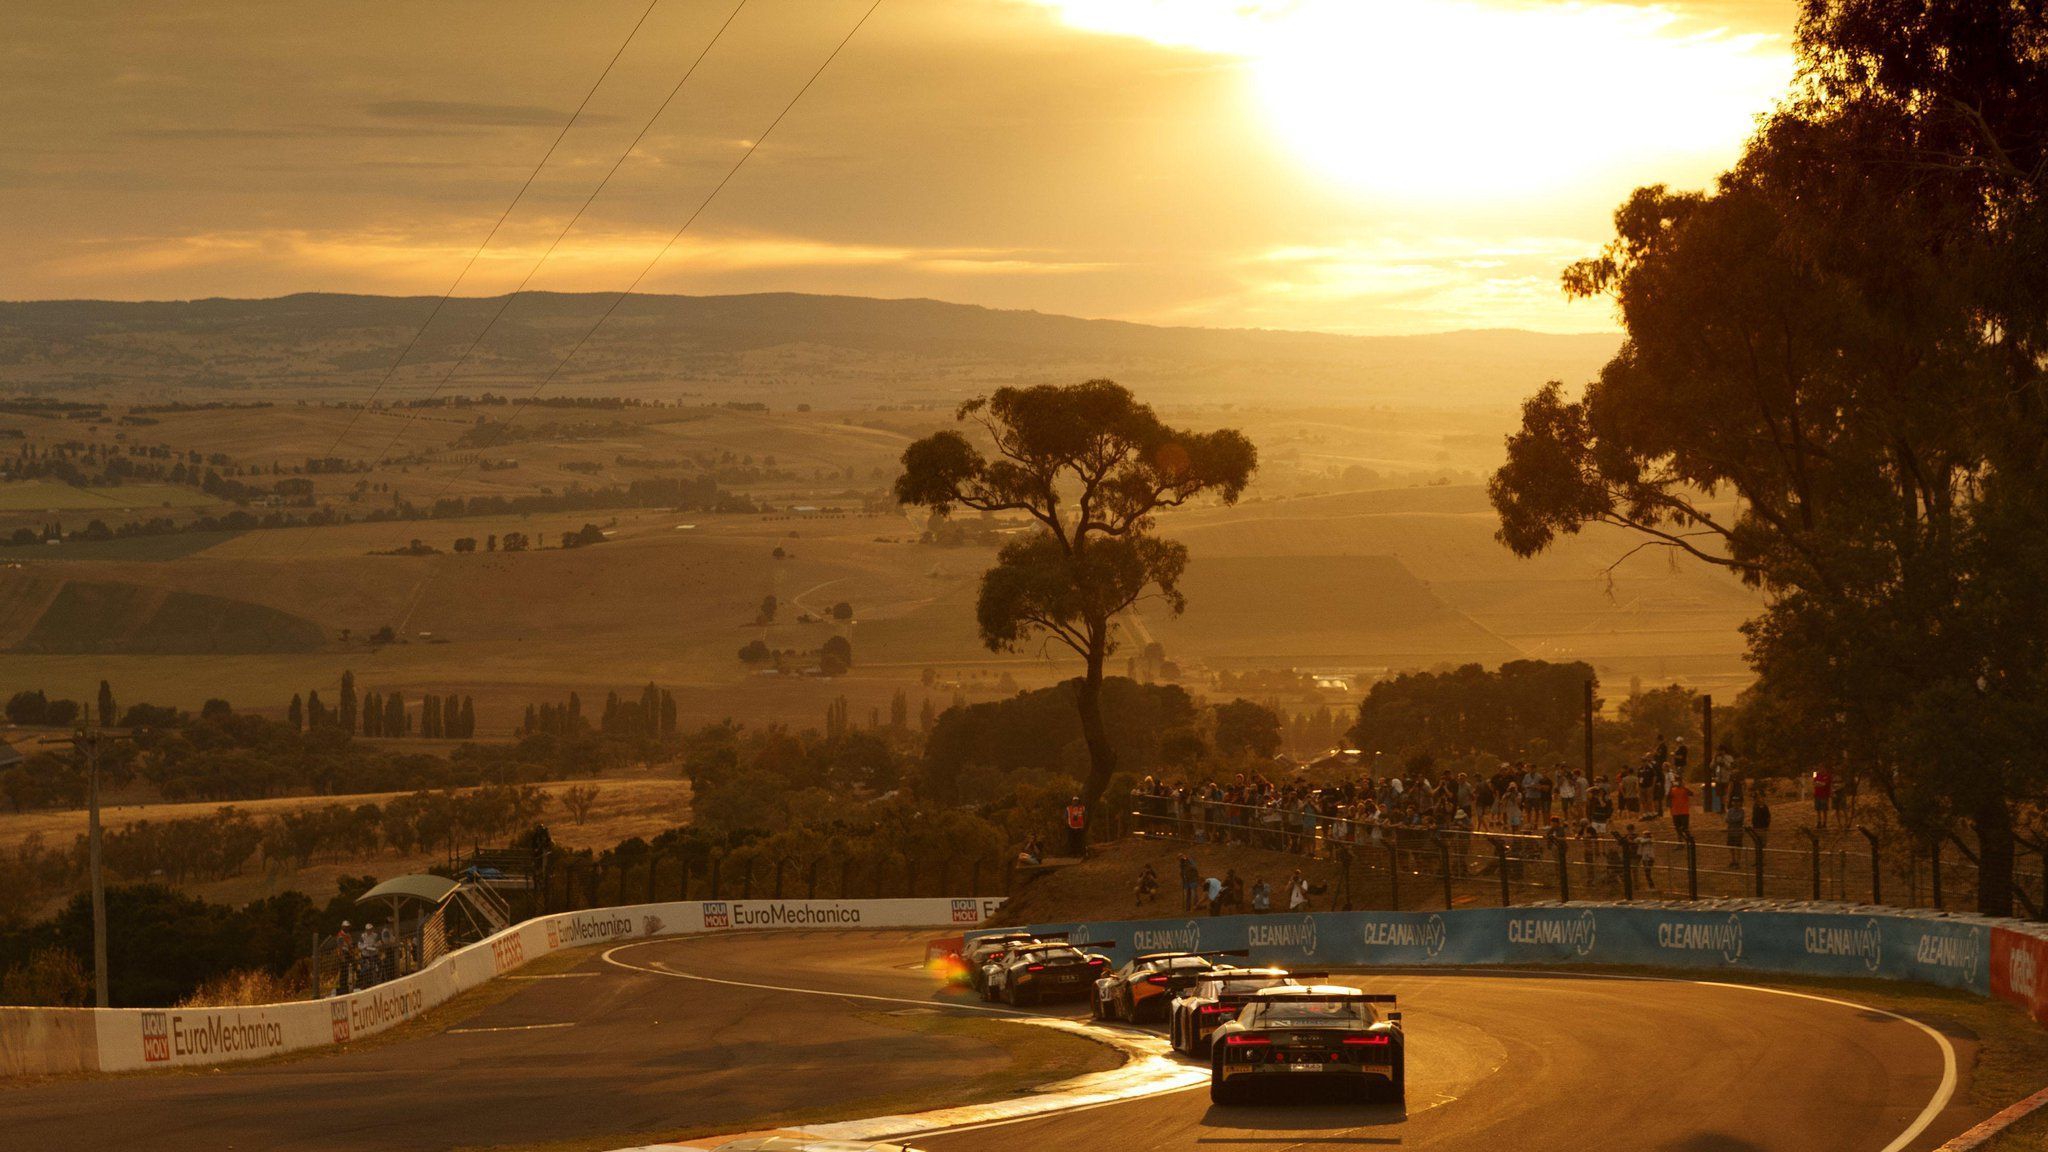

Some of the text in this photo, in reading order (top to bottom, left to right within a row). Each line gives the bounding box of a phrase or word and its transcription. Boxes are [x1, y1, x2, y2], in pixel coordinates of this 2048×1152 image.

[704, 903, 727, 915] LIQUI
[734, 904, 860, 924] EuroMechanica
[952, 900, 976, 911] LIQUI
[953, 911, 977, 921] MOLY
[557, 915, 632, 943] EuroMechanica
[705, 915, 728, 927] MOLY
[1508, 919, 1592, 944] CLEANAWAY
[1134, 929, 1195, 951] CLEANAWAY
[1249, 924, 1313, 946] CLEANAWAY
[1365, 922, 1441, 946] CLEANAWAY
[1658, 922, 1738, 950] CLEANAWAY
[1805, 926, 1877, 956] CLEANAWAY
[1917, 934, 1978, 969] CLEANAWAY
[351, 983, 422, 1031] EuroMechanica
[143, 1014, 166, 1036] LIQUI
[173, 1013, 282, 1056] EuroMechanica
[145, 1038, 168, 1059] MOLY
